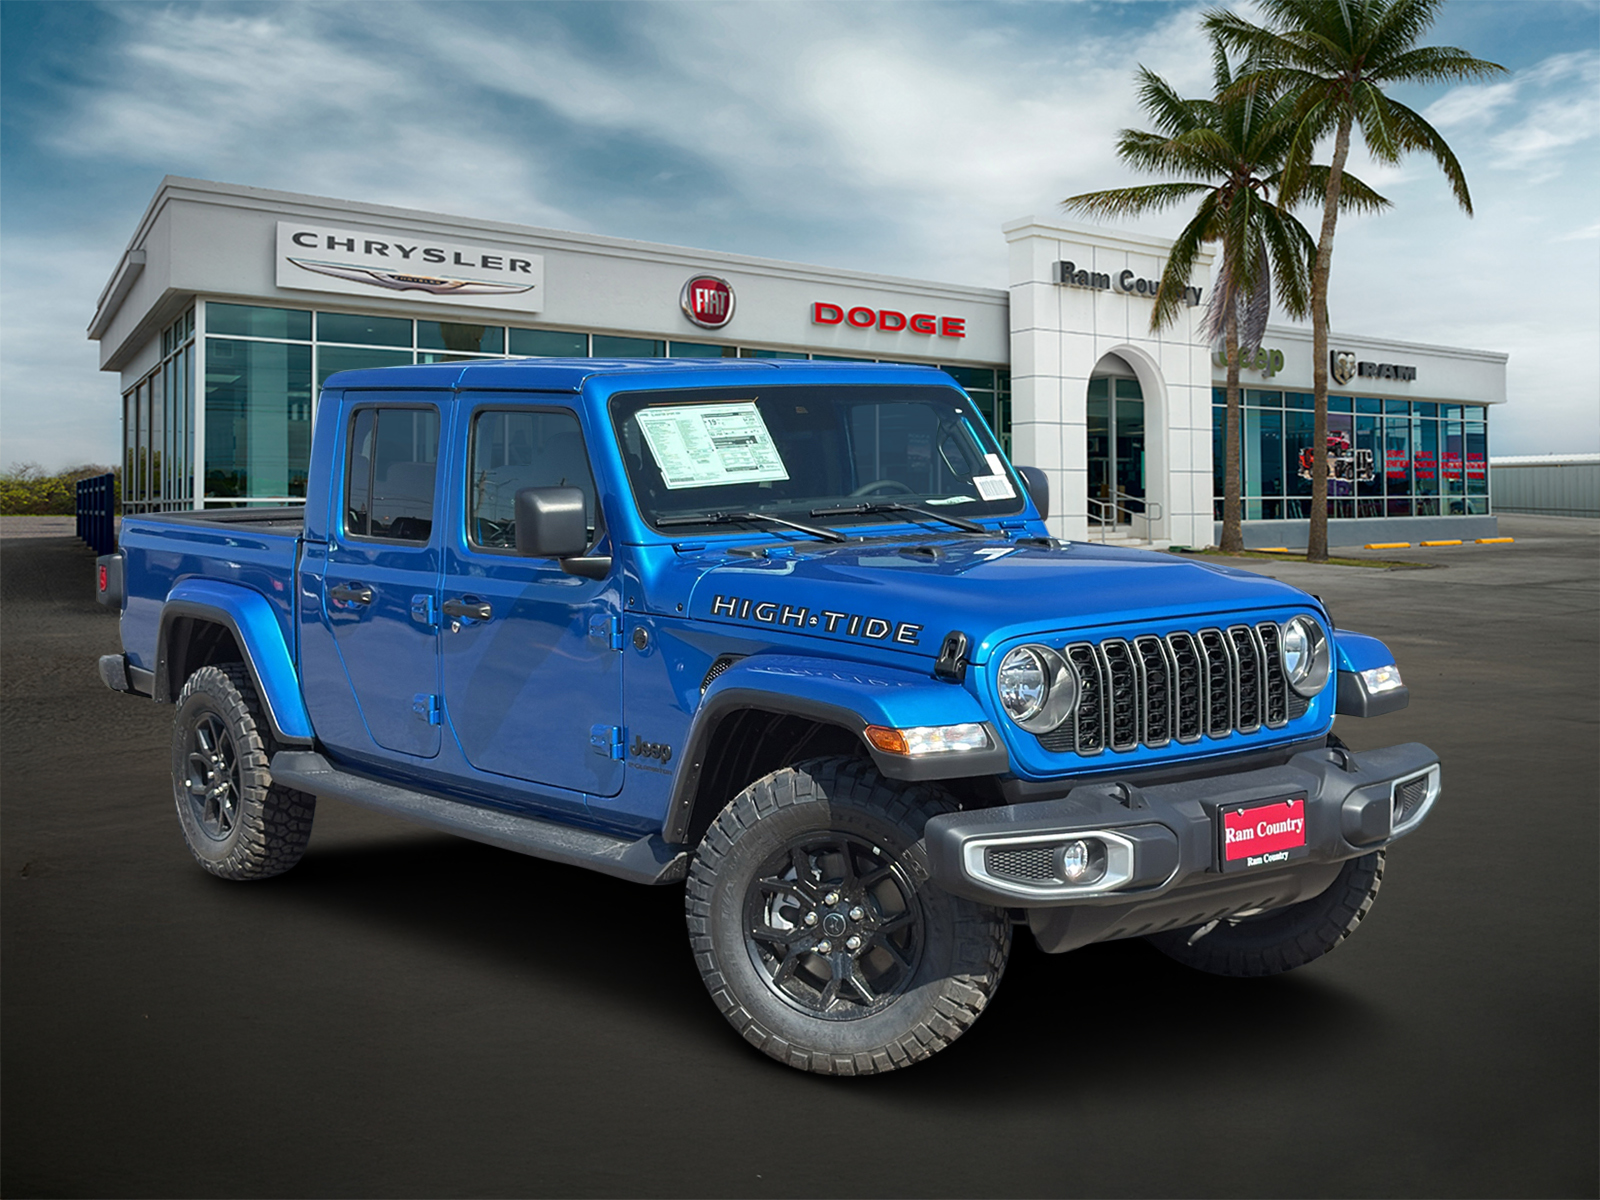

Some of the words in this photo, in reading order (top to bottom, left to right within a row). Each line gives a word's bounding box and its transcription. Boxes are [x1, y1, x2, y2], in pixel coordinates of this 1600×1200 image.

[292, 232, 532, 273] CHRYSLER
[1054, 260, 1110, 291] Ram
[695, 287, 728, 316] FIAT
[811, 302, 966, 339] DODGE
[1358, 361, 1416, 381] RAM
[711, 595, 810, 628] HIGH
[821, 610, 924, 646] TIDE
[630, 735, 672, 764] Jeep
[1225, 828, 1254, 843] Ram
[1257, 818, 1304, 837] Country
[1247, 857, 1262, 867] Ram
[1263, 852, 1288, 863] Country
